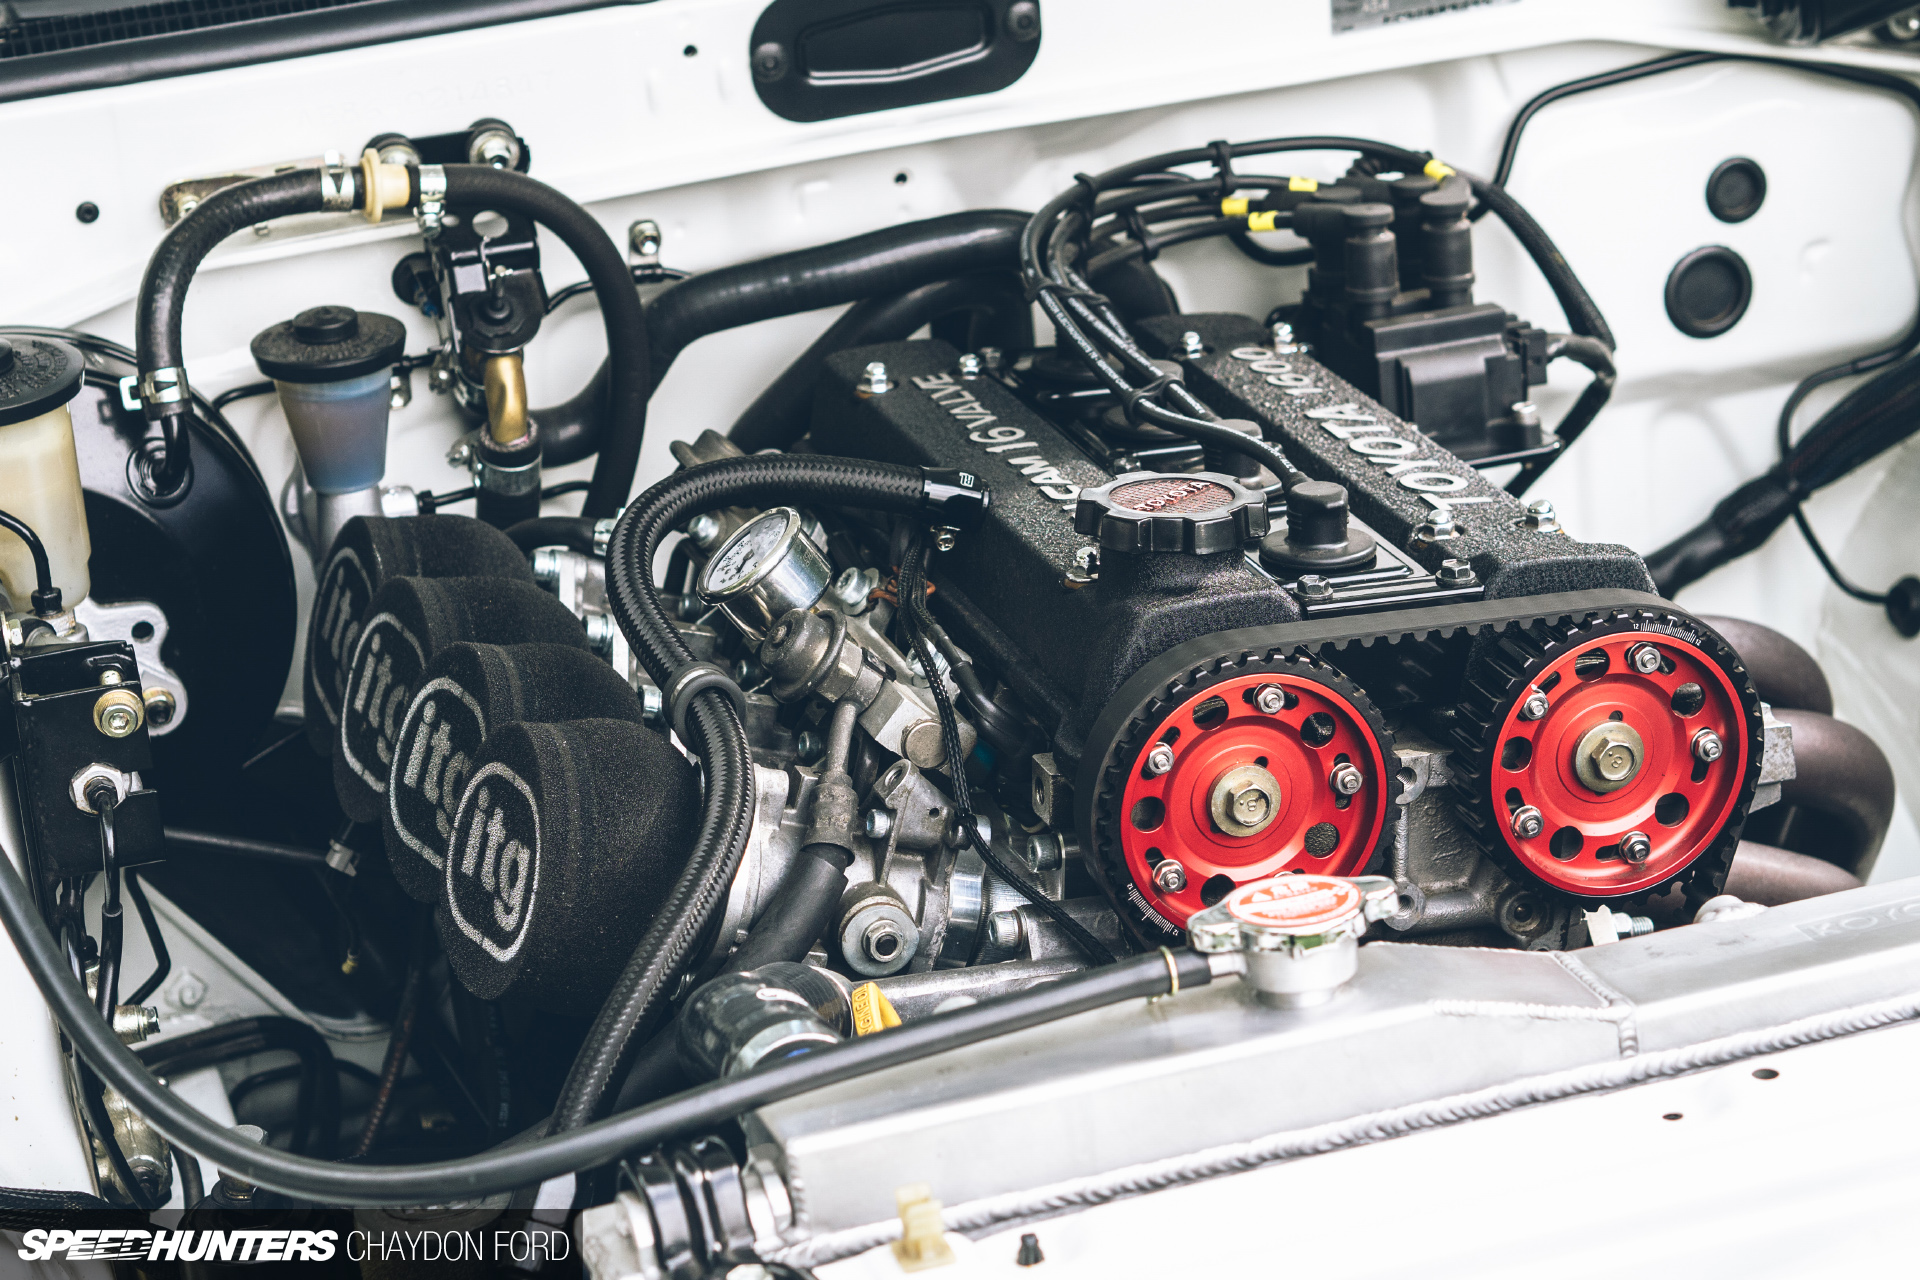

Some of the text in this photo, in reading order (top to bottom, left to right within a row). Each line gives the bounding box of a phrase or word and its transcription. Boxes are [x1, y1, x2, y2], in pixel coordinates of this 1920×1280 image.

[1231, 347, 1323, 395] 1600
[911, 372, 1082, 500] CAM 16 VALVE
[1303, 403, 1493, 511] TOYOTA
[1133, 481, 1212, 512] TOYOTA
[1695, 638, 1702, 646] 12
[461, 786, 531, 931] itg
[855, 1001, 873, 1035] NGINE
